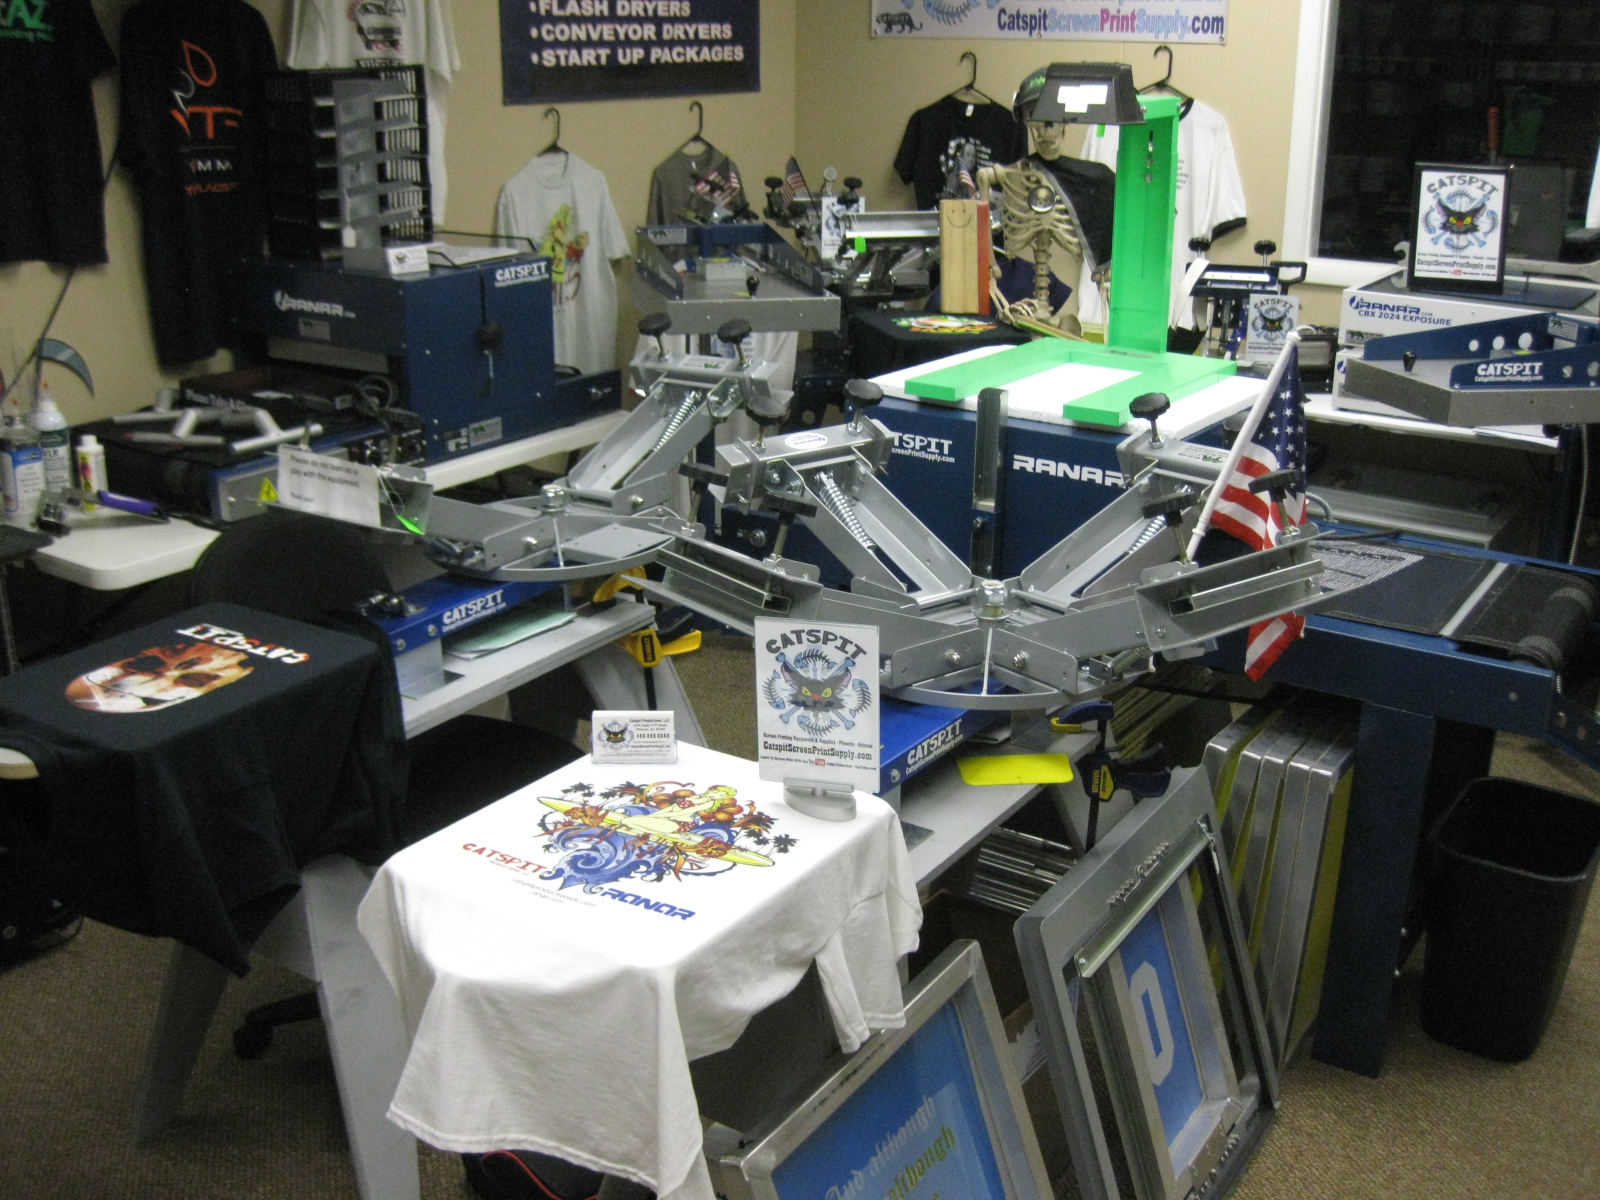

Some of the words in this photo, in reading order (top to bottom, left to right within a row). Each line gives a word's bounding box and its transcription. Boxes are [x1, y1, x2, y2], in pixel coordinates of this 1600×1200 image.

[538, 0, 609, 16] FLASH
[616, 0, 691, 17] DRYERS
[541, 23, 657, 41] CONVEYOR
[662, 23, 733, 40] DRYERS
[997, 8, 1224, 39] CatspitScreenPrintSupply.com
[541, 48, 611, 67] START
[617, 47, 645, 65] UP
[650, 45, 744, 63] PACKAGES
[1426, 174, 1499, 196] CATSPIT
[495, 261, 547, 281] CATSPIT
[1253, 298, 1294, 310] CATSPIT
[1358, 309, 1376, 318] CBX
[1378, 311, 1400, 320] 2024
[1402, 314, 1452, 326] EXPOSURE
[1477, 362, 1543, 376] CATSPIT
[893, 431, 952, 454] TSPIT
[1013, 454, 1125, 488] RANAR
[443, 589, 504, 625] CATSPIT
[766, 629, 867, 660] CATSPIT
[777, 733, 792, 741] Printing
[793, 735, 814, 743] Equipment
[907, 718, 962, 765] CATSPIT
[763, 741, 872, 760] CatspitScreenPrintSupply.com
[462, 843, 548, 874] CATSPIT
